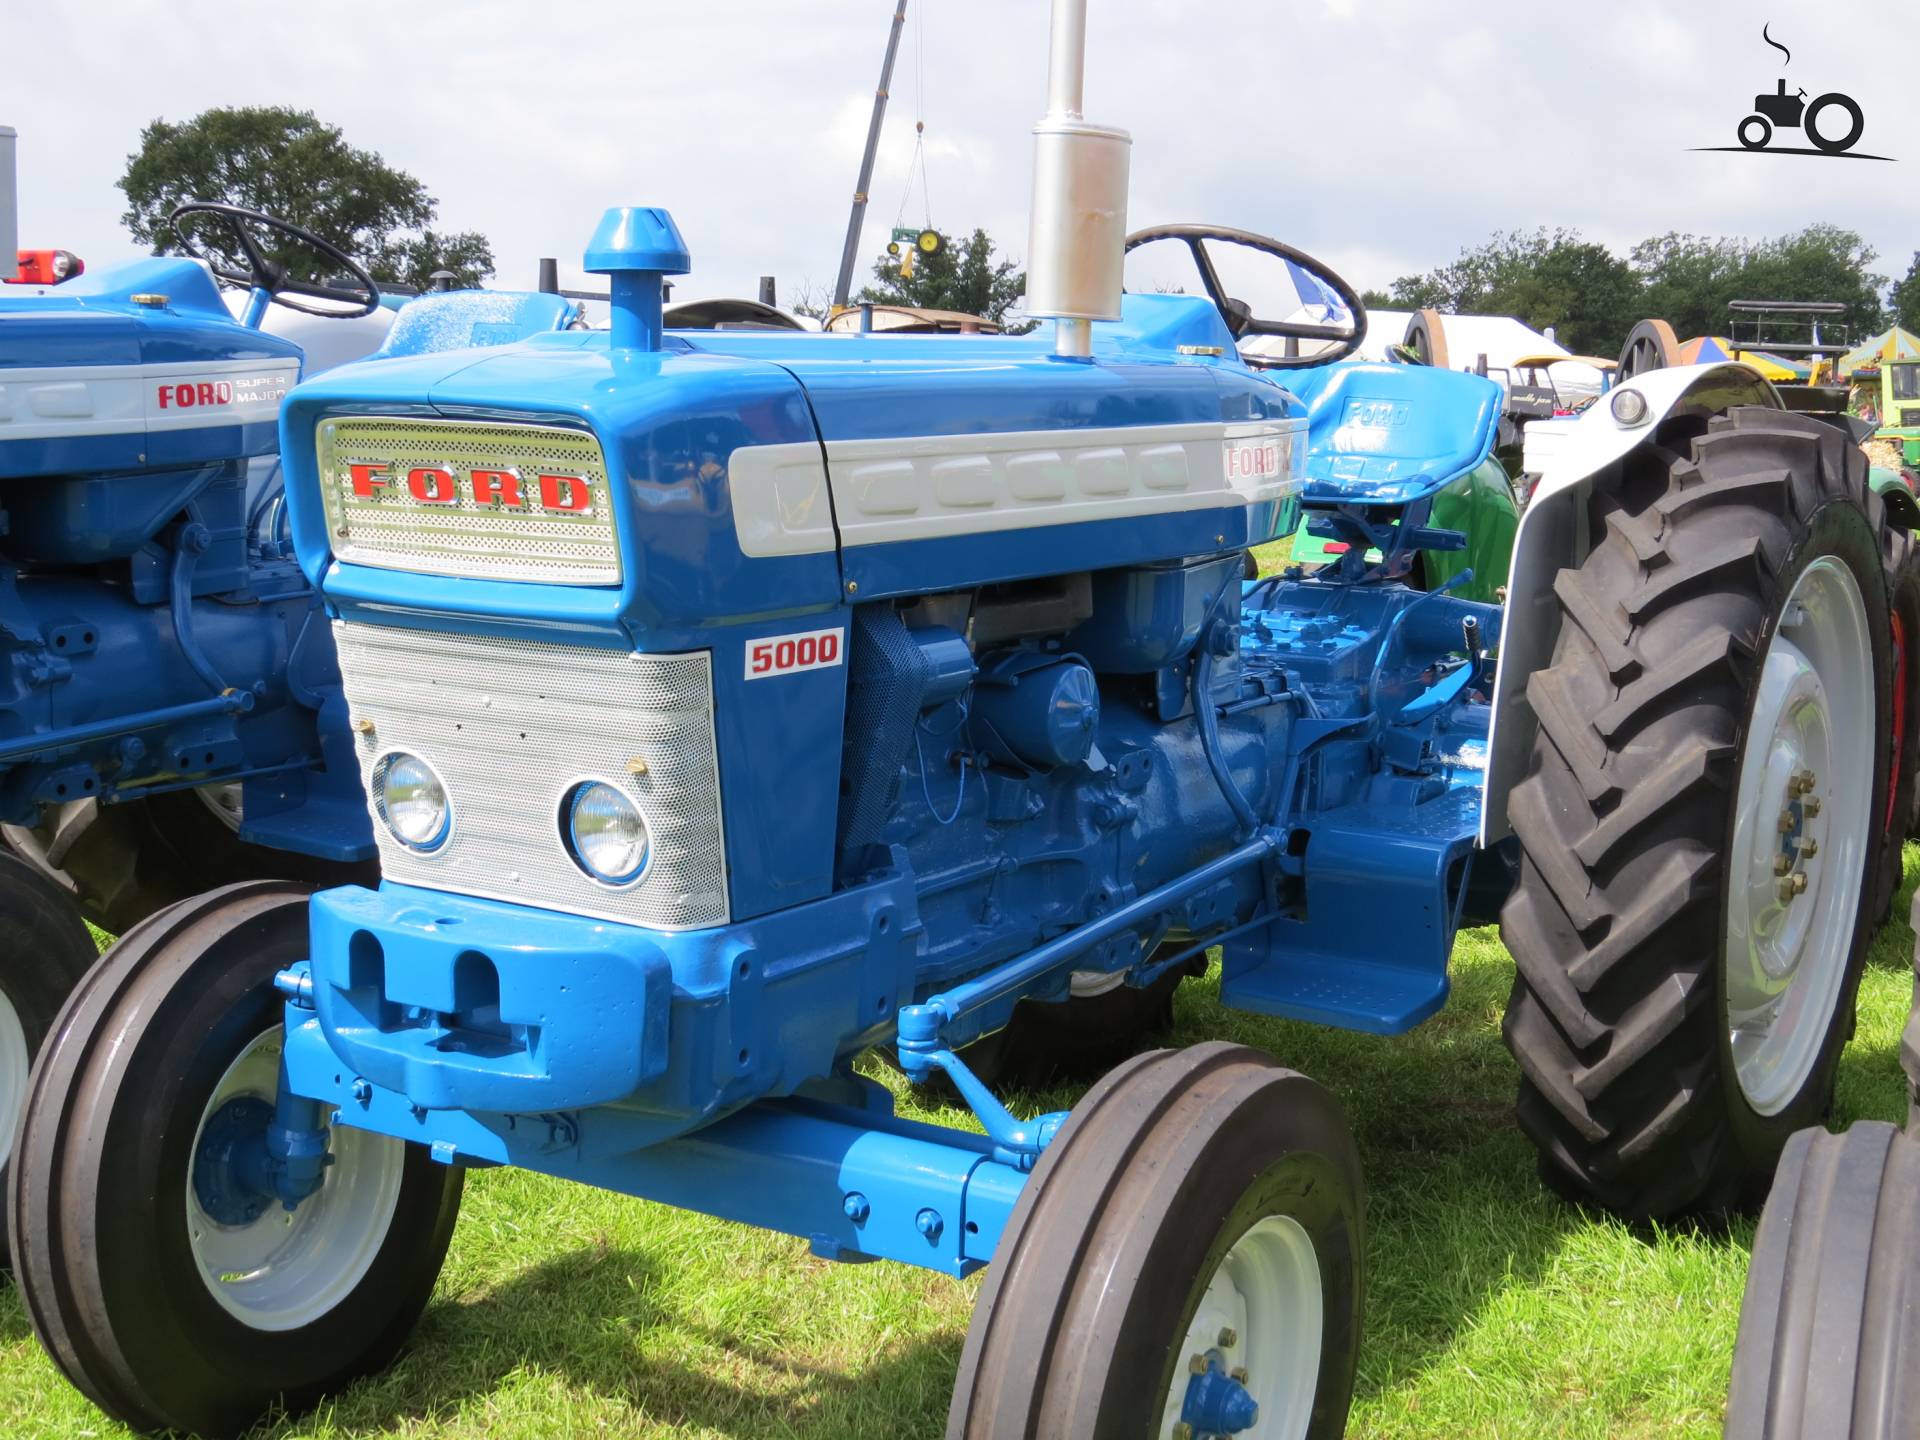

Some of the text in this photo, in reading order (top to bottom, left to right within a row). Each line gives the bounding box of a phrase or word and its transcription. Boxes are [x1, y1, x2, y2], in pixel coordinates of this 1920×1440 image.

[158, 376, 285, 409] FORD SUPER
[1226, 446, 1278, 478] FORD
[349, 459, 596, 516] FORD
[752, 634, 838, 673] 5000
